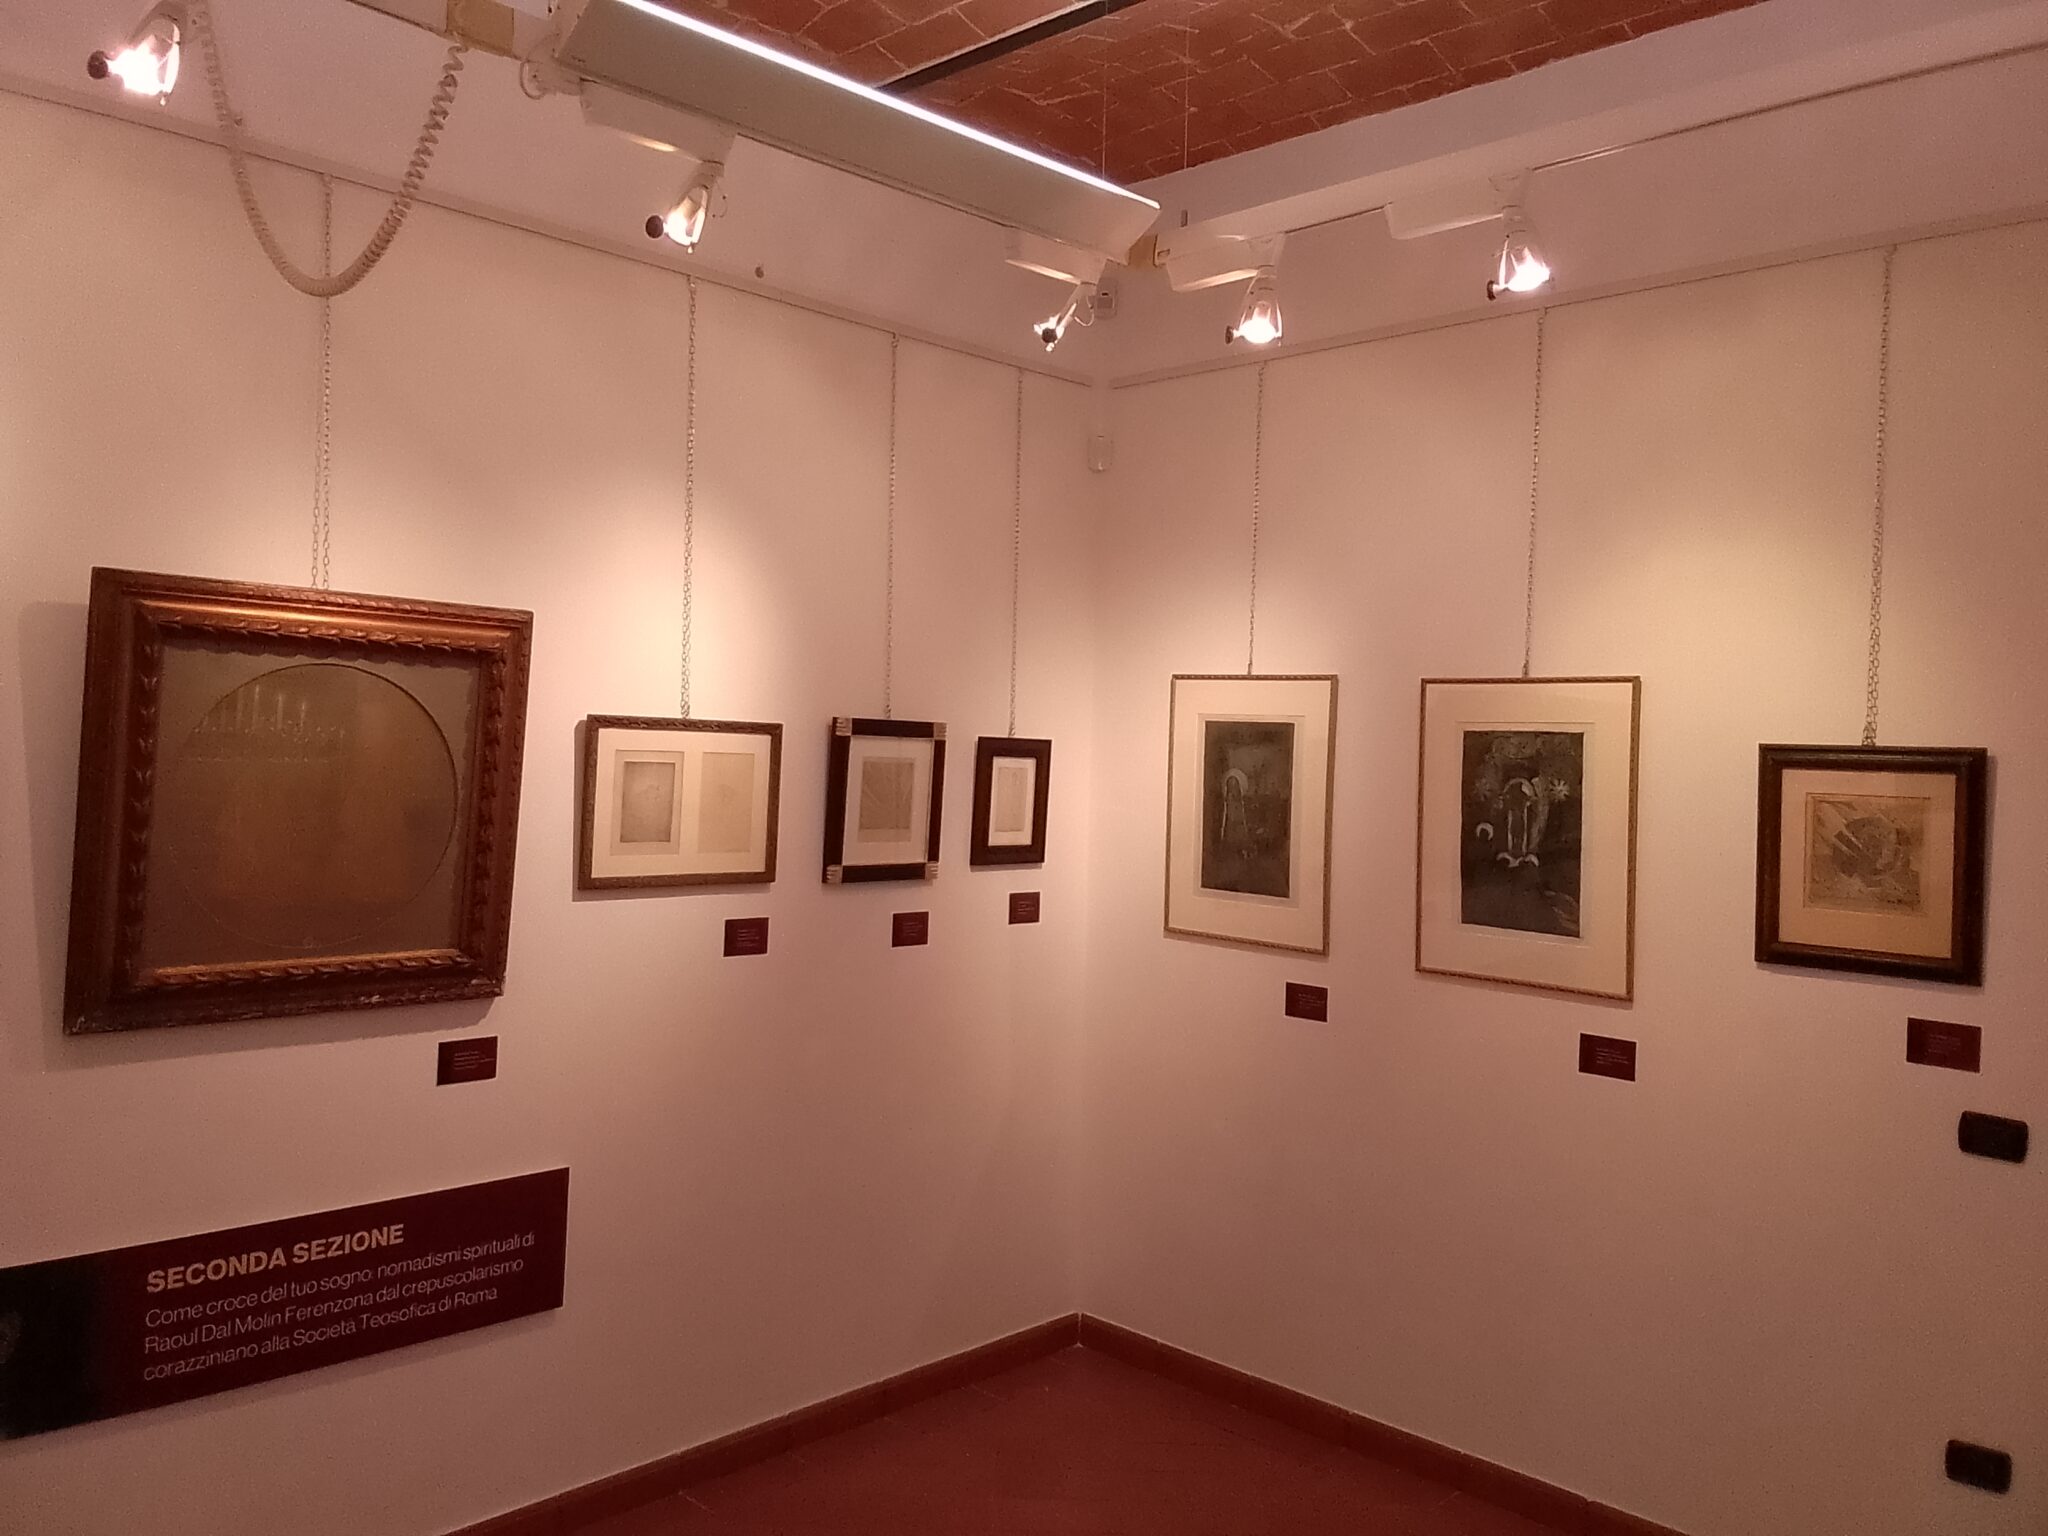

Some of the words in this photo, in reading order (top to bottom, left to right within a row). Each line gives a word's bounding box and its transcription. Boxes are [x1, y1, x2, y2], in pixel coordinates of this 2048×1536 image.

[145, 1304, 204, 1328] Come
[206, 1293, 258, 1315] croce
[260, 1282, 288, 1304] del
[290, 1279, 318, 1298] tuo
[376, 1247, 461, 1280] nomadismi
[462, 1233, 521, 1262] spirituali
[522, 1231, 535, 1246] di
[146, 1247, 287, 1293] SECONDA
[292, 1223, 405, 1264] SEZIONE
[143, 1343, 259, 1381] corazziniano
[260, 1335, 290, 1355] alla
[292, 1320, 357, 1347] Società
[360, 1302, 437, 1330] Teosofica
[438, 1296, 452, 1312] di
[453, 1286, 498, 1308] Roma
[144, 1326, 199, 1355] Raoul
[201, 1320, 231, 1343] Dal
[234, 1312, 282, 1336] Molin
[284, 1292, 374, 1325] Ferenzona
[376, 1283, 401, 1303] dal
[402, 1258, 525, 1297] crepuscolarismo
